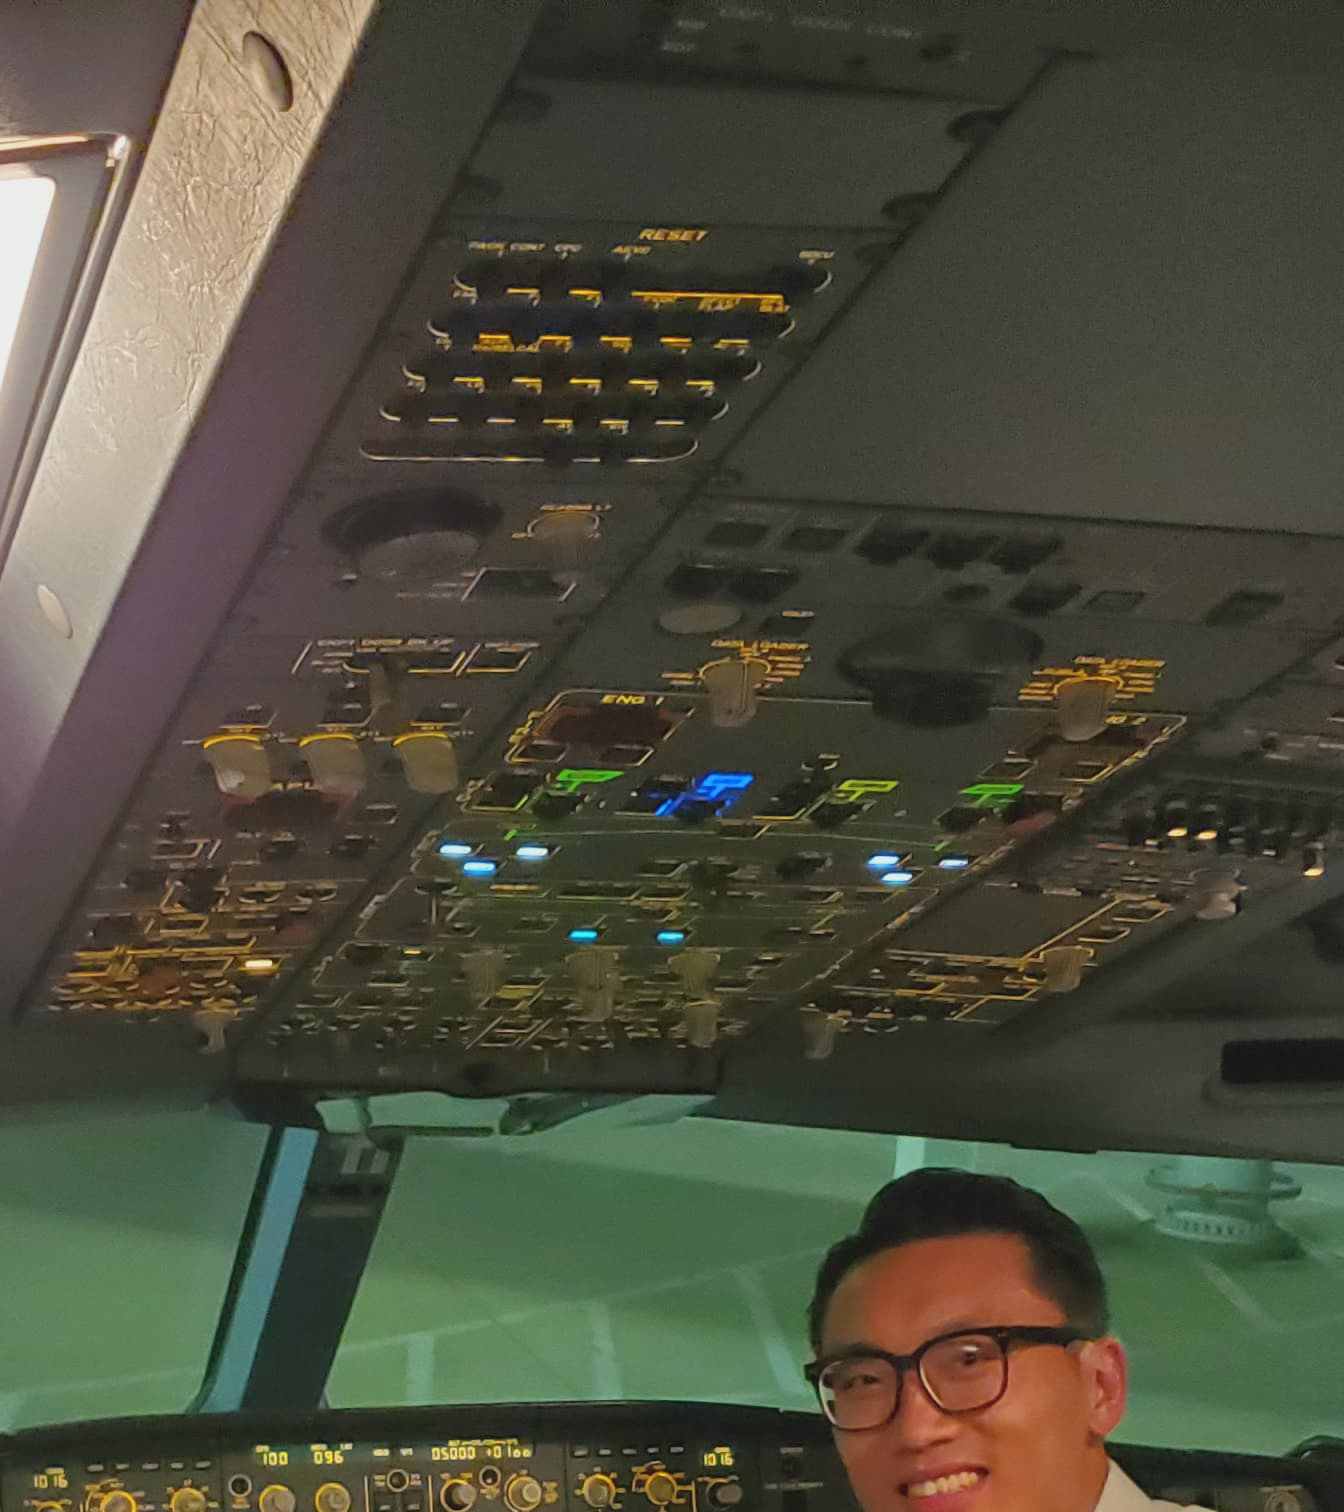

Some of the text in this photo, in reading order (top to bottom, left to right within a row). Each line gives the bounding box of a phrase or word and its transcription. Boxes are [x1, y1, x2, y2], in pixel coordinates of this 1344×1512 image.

[639, 229, 707, 241] RESET
[601, 695, 645, 704] ENG
[263, 1452, 288, 1465] 100
[314, 1451, 344, 1464] 096
[432, 1447, 476, 1460] 05000
[704, 1453, 734, 1466] 1016
[33, 1475, 68, 1488] 1016
